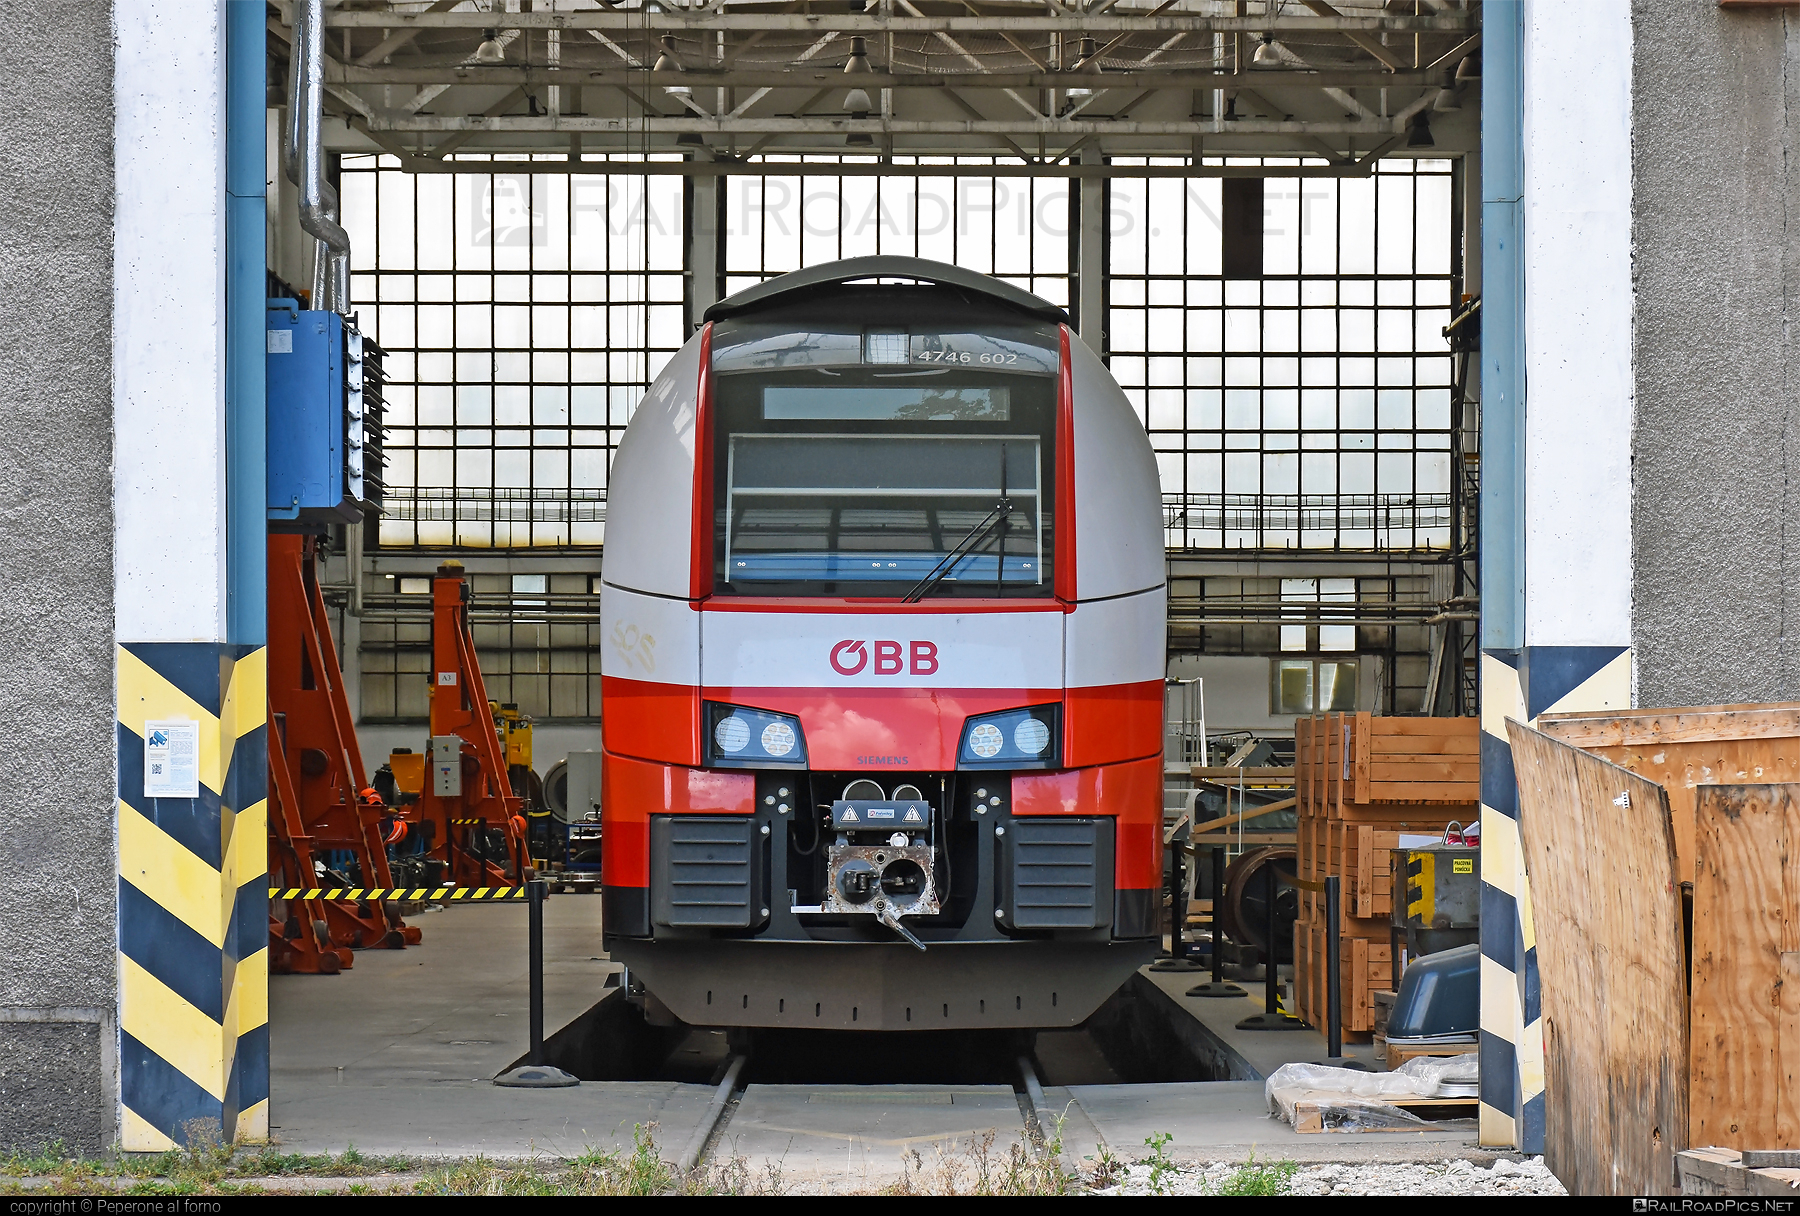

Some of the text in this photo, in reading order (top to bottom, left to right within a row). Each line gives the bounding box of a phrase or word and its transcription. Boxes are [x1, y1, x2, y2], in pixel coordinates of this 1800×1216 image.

[918, 351, 1018, 365] 4746 602
[830, 639, 939, 676] ÖBB
[857, 755, 909, 765] SIEMENS
